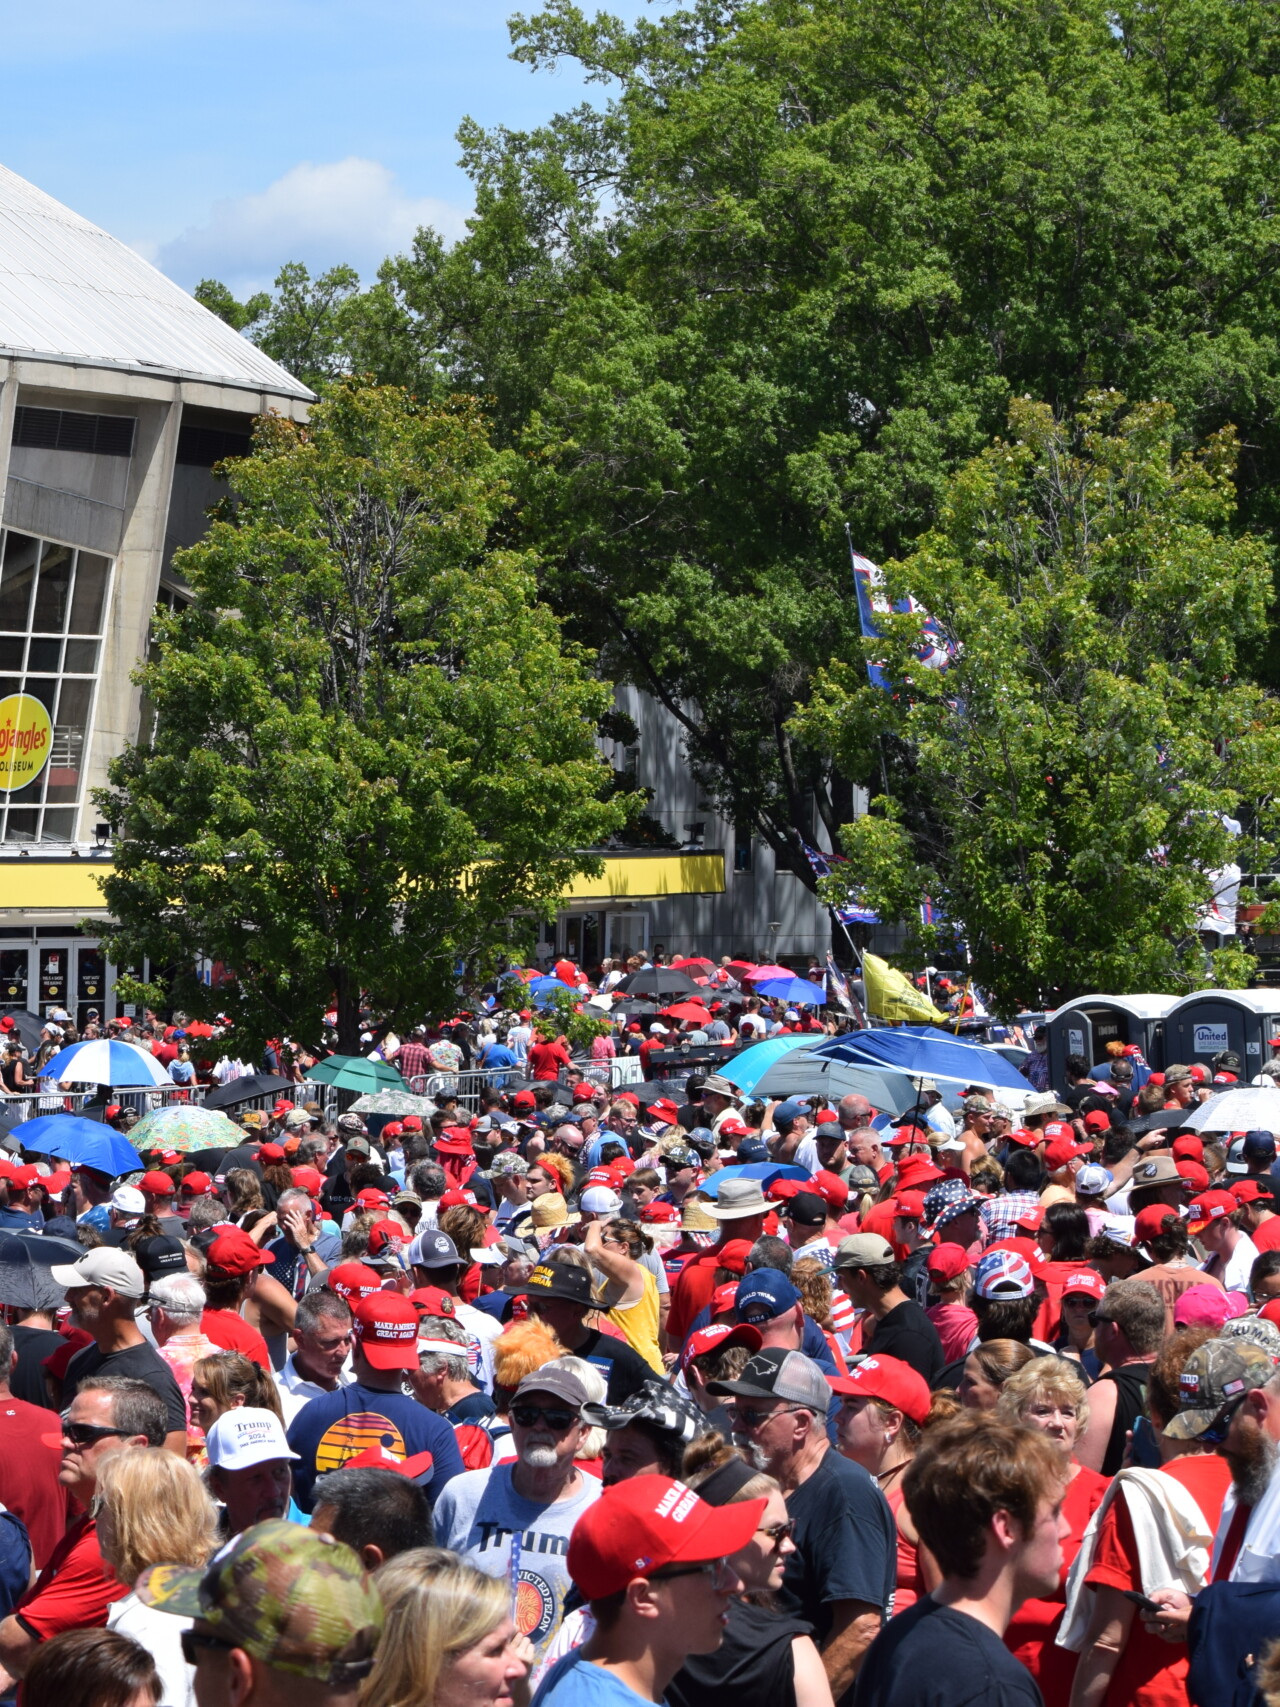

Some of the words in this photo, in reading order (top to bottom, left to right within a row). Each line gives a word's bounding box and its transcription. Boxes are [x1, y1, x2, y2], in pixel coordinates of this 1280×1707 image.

[1197, 1032, 1227, 1041] United
[757, 1291, 776, 1303] TRUMP
[747, 1314, 765, 1323] 2024
[374, 1321, 393, 1330] MAKE
[376, 1330, 399, 1338] GREAT
[399, 1330, 415, 1339] AGAIN
[234, 1421, 272, 1432] Trump
[654, 1487, 682, 1518] MAKE
[475, 1521, 570, 1557] Trum
[517, 1570, 550, 1597] VICTED
[538, 1595, 554, 1633] FELON
